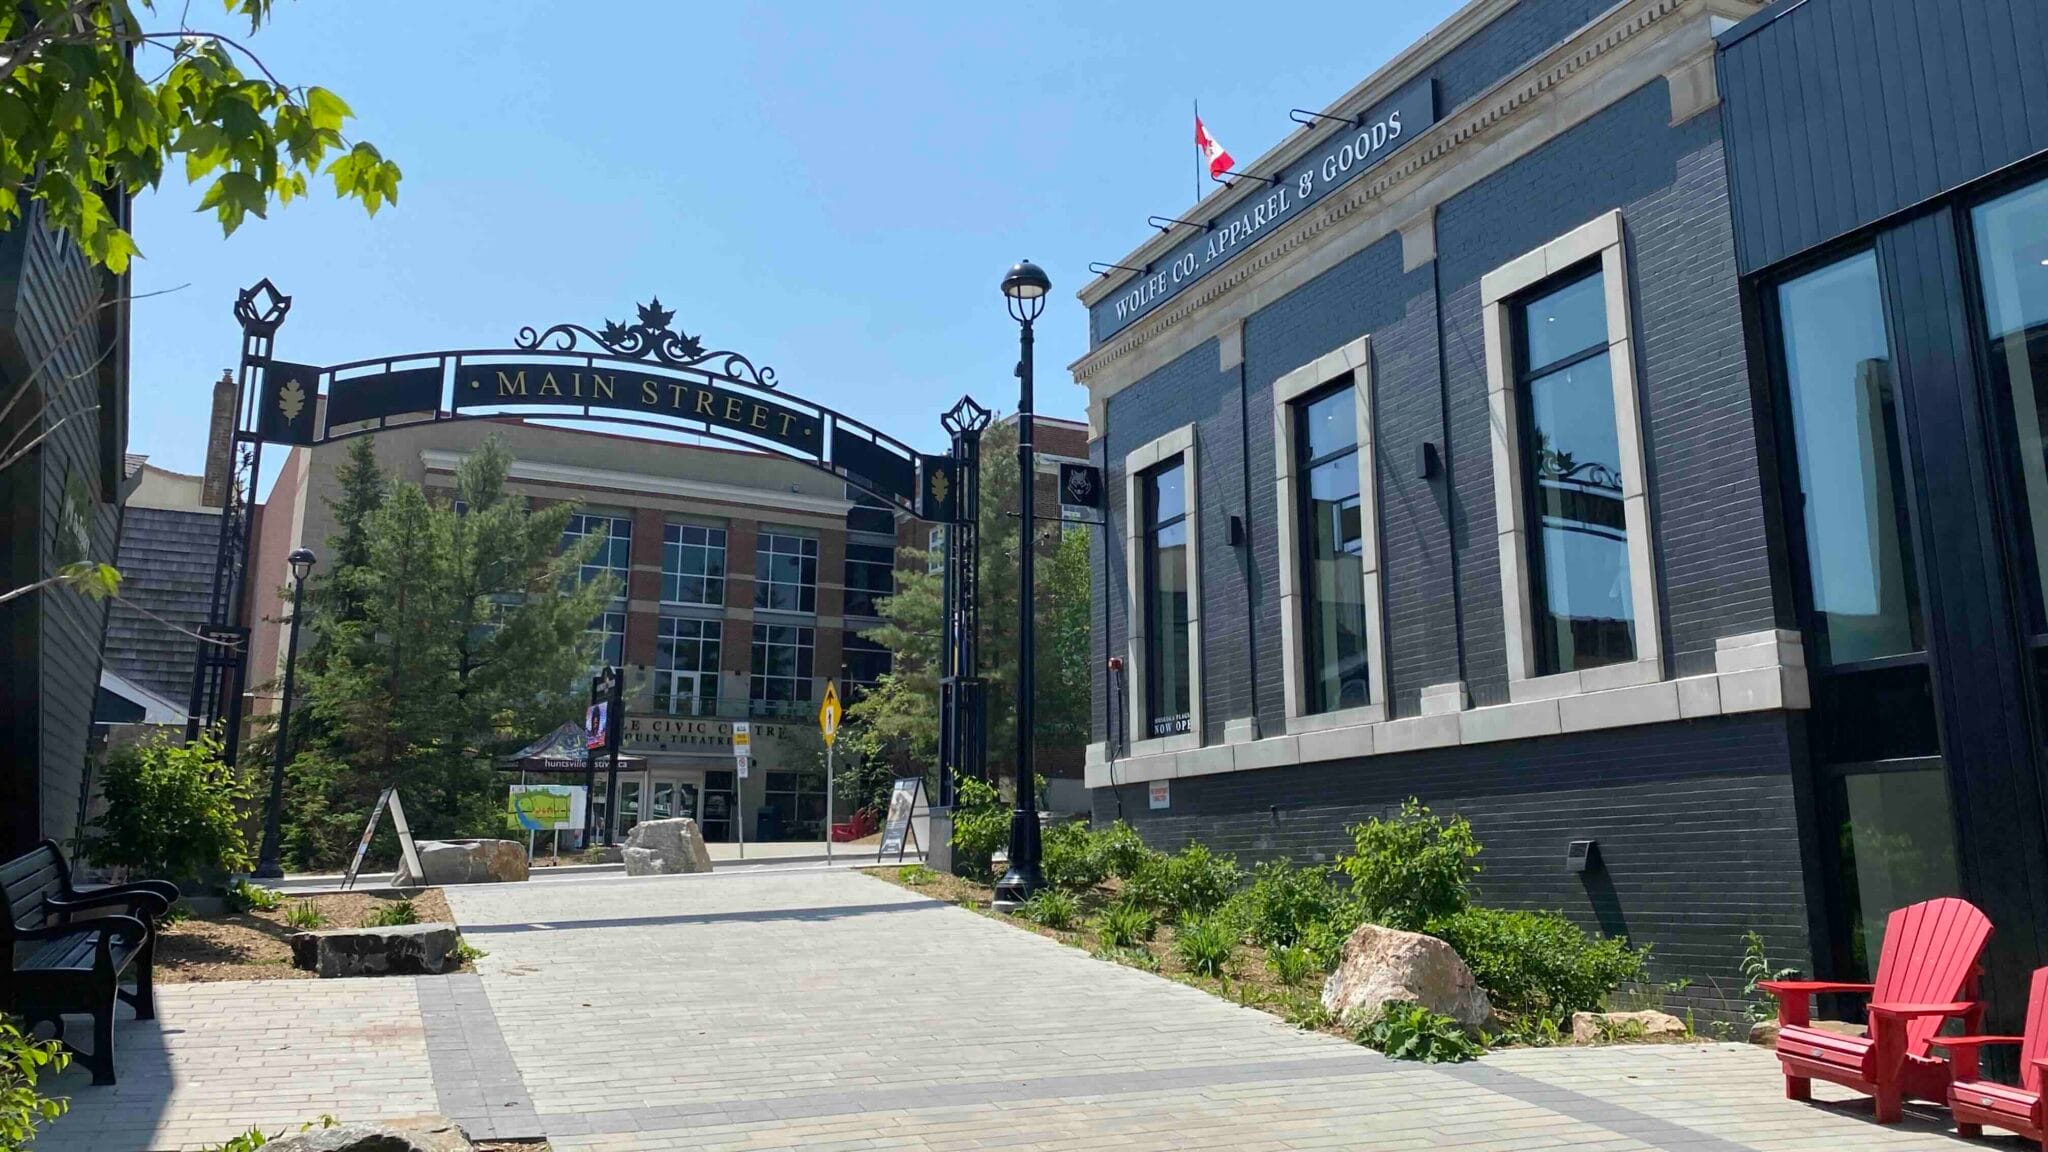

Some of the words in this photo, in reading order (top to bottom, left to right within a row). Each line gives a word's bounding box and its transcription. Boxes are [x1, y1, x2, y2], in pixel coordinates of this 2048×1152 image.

[1115, 277, 1168, 321] WOLFE
[1172, 252, 1200, 284] CO.
[1206, 188, 1291, 263] APPAREL
[1299, 170, 1315, 199] &
[1322, 110, 1402, 183] GOODS
[496, 370, 615, 399] MAIN
[641, 381, 797, 436] STREET
[652, 721, 706, 734] CIVIC
[718, 722, 786, 740] CTRE
